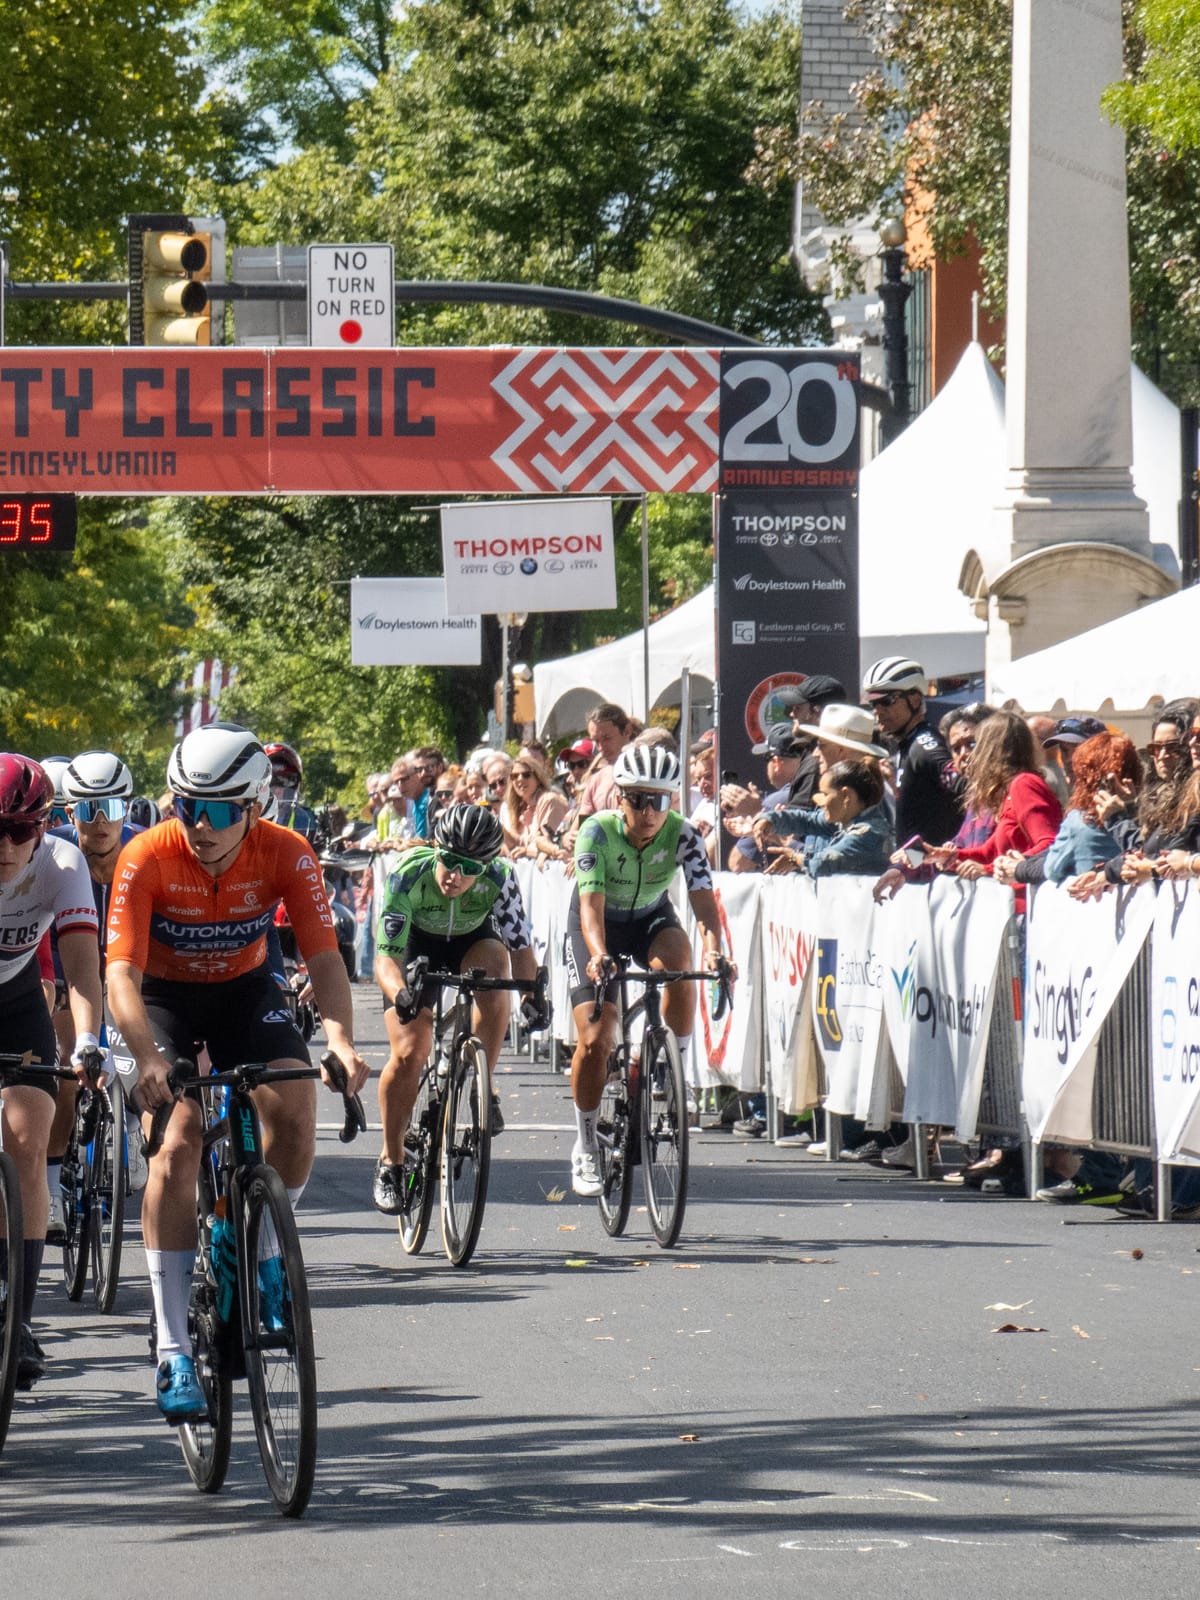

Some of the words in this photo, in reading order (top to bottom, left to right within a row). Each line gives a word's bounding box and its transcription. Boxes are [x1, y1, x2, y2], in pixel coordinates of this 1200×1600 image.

[334, 251, 367, 270] NO
[327, 277, 375, 293] TURN
[317, 300, 341, 316] ON
[350, 300, 385, 315] RED
[123, 367, 436, 437] CLASSIC
[722, 359, 857, 464] 20
[722, 469, 858, 486] ANNIVERSARY
[732, 516, 846, 531] THOMPSON
[453, 535, 602, 558] THOMPSON
[749, 579, 809, 592] Doylestown
[812, 579, 846, 590] Health
[374, 618, 438, 632] Doylestown
[442, 618, 477, 629] Health
[759, 623, 793, 631] Eastburn
[795, 623, 809, 631] and
[811, 623, 832, 632] Gray,
[110, 862, 138, 925] PISSEI
[305, 873, 332, 928] PISSEI
[158, 913, 270, 938] AUTOMATIC
[239, 1107, 255, 1152] BMC
